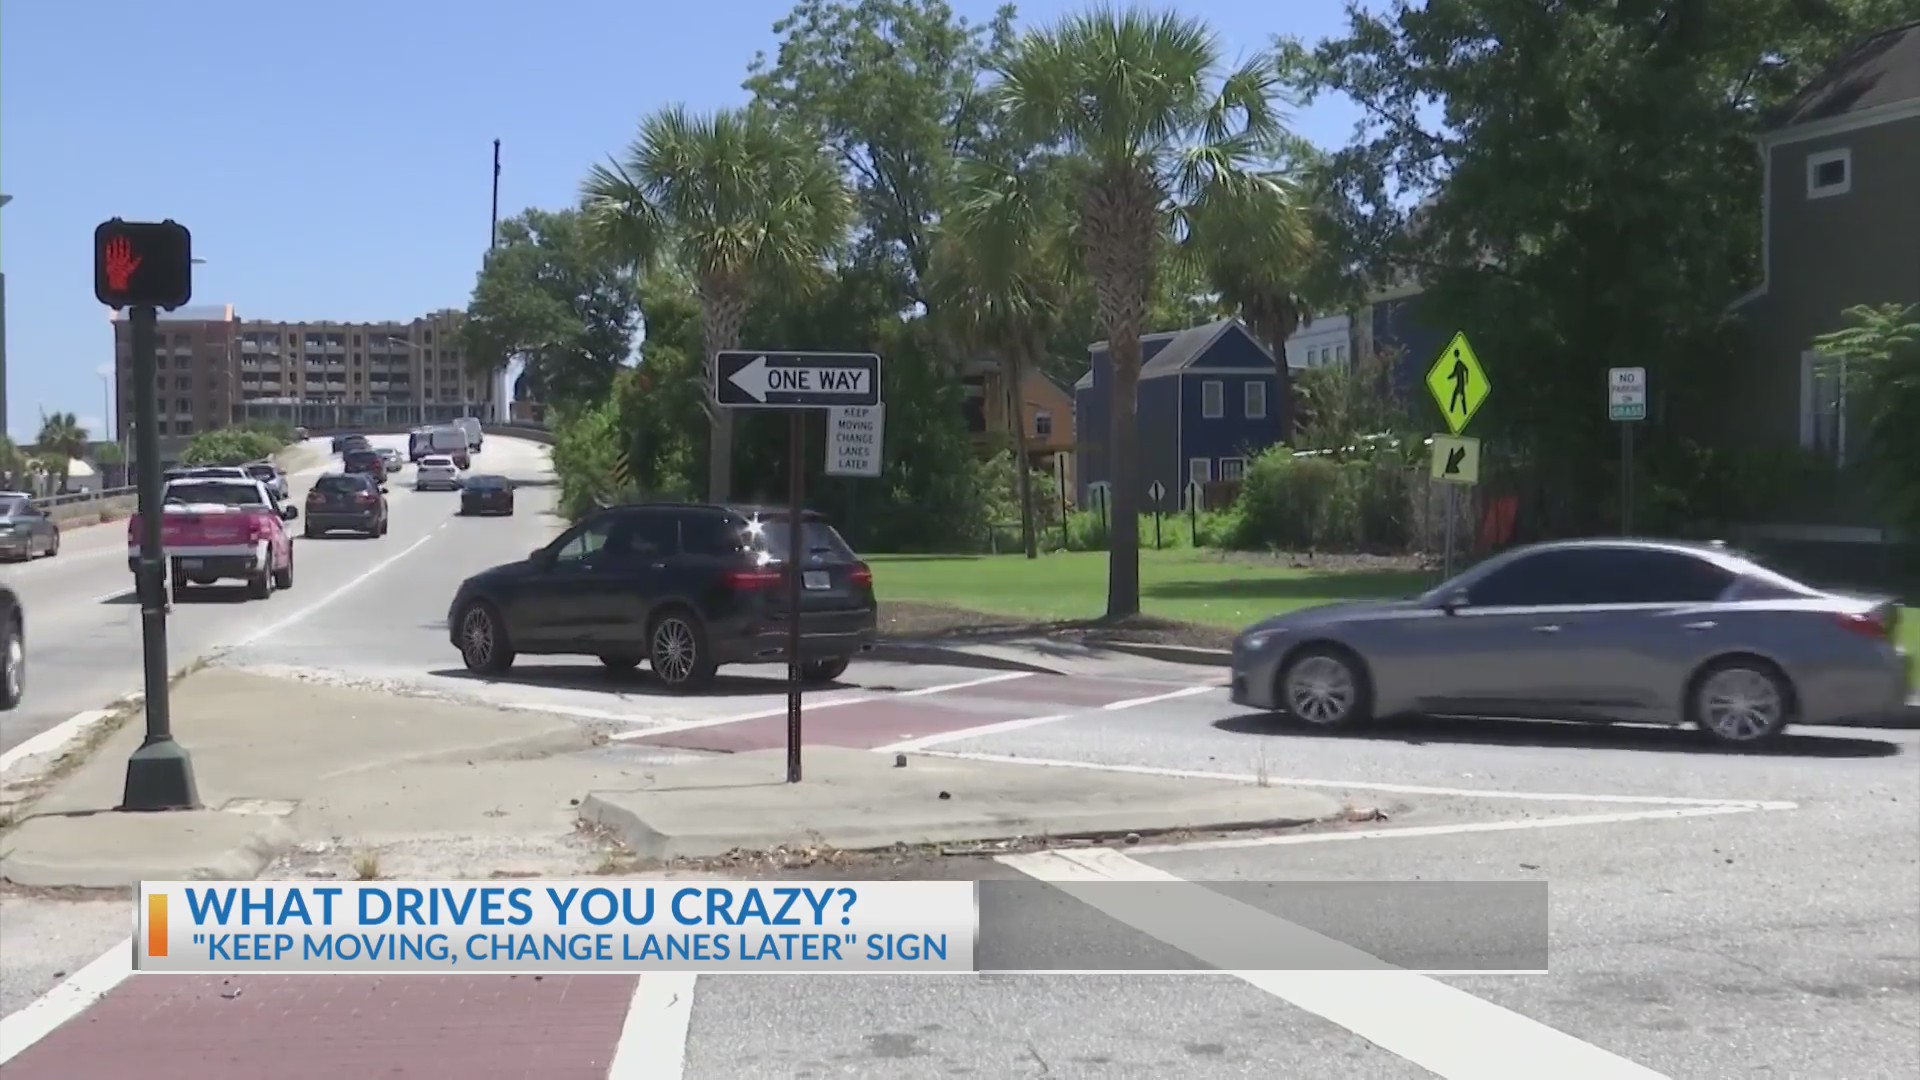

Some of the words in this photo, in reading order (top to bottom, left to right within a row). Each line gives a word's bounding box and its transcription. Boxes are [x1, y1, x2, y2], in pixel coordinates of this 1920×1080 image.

[768, 369, 811, 390] ONE
[819, 370, 862, 390] WAY
[1619, 373, 1635, 383] NO
[844, 407, 869, 418] KEEP
[838, 419, 873, 431] MOVING
[836, 432, 873, 444] CHANGE
[838, 446, 870, 457] LANES
[838, 459, 868, 470] LATER
